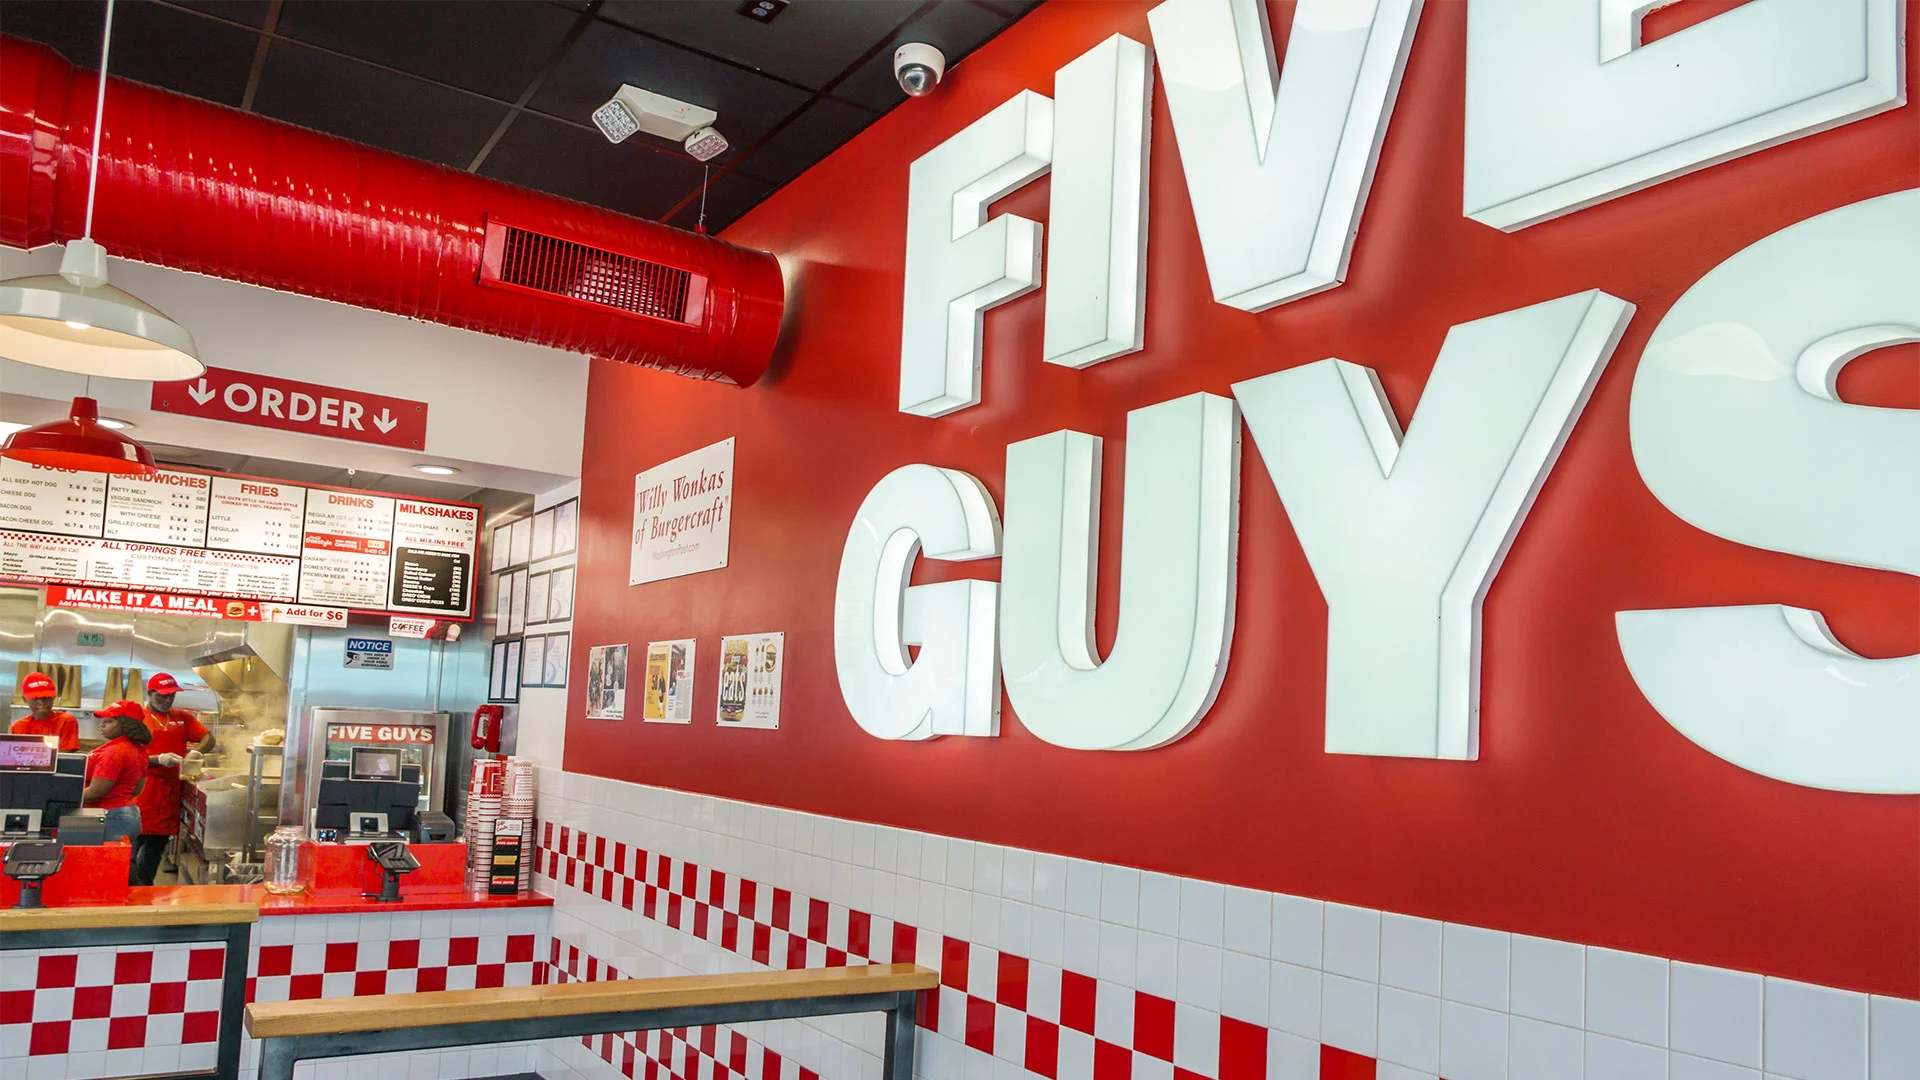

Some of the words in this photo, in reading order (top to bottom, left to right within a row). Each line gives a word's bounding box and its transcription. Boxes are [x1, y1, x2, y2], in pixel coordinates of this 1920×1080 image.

[223, 382, 365, 431] ORDER
[240, 484, 279, 497] FRIES
[673, 468, 725, 503] Wonkas
[833, 188, 1920, 795] GUYS
[0, 489, 23, 497] CHEESE
[132, 497, 162, 505] SANDWICH
[328, 494, 374, 509] DRINKS
[137, 512, 161, 520] CHEESE
[308, 511, 335, 519] REGULAR
[400, 503, 474, 521] MILKSHAKES
[18, 517, 40, 525] CHEESE
[108, 519, 134, 527] GRILLED
[634, 518, 648, 550] of
[101, 541, 122, 550] ALL
[125, 543, 177, 555] TOPPINGS
[179, 549, 207, 558] FREE
[303, 564, 333, 572] DOMESTIC
[65, 588, 122, 604] MAKE
[127, 593, 145, 605] IT
[149, 595, 168, 608] A
[168, 597, 218, 611] MEAL
[286, 607, 307, 618] Add
[309, 609, 324, 618] for
[326, 610, 343, 621] $6
[391, 623, 424, 632] COFFEE
[349, 640, 390, 651] NOTICE
[723, 664, 746, 701] eats
[328, 726, 373, 741] FIVE
[377, 727, 433, 742] GUYS
